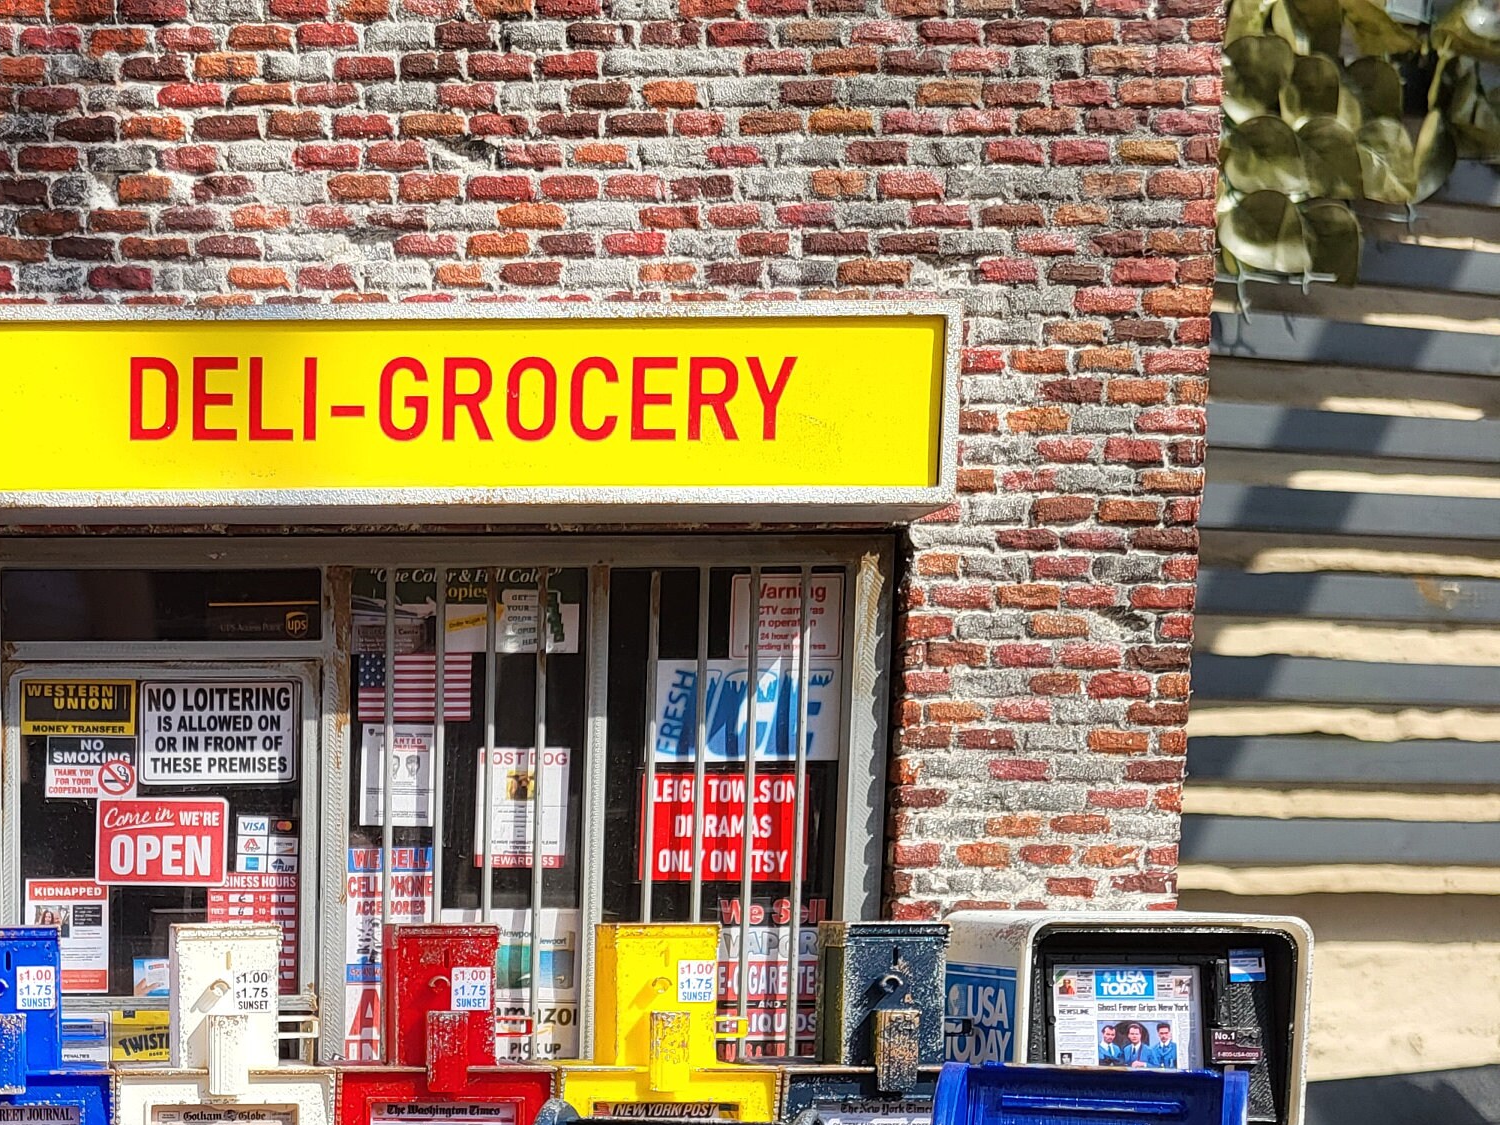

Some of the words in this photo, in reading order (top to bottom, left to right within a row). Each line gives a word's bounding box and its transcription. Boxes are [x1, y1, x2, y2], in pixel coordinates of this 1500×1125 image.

[128, 356, 798, 441] DELI-GROCERY
[26, 685, 114, 698] WESTERN
[53, 697, 114, 710] UNION
[146, 687, 176, 712] NO
[182, 687, 291, 712] LOITERING
[656, 668, 697, 755] FRESH
[32, 725, 68, 733] MONEY
[72, 725, 125, 734] TRANSFER
[157, 715, 173, 732] IS
[177, 715, 254, 732] ALLOWED
[257, 715, 281, 731] ON
[80, 740, 104, 751] NO
[154, 736, 178, 752] OR
[182, 736, 199, 752] IN
[203, 736, 257, 752] FRONT
[262, 735, 283, 752] OF
[53, 751, 131, 764] SMOKING
[150, 757, 203, 774] THESE
[207, 757, 288, 774] PREMISES
[53, 768, 77, 777] THANK
[79, 768, 94, 776] YOU
[48, 786, 99, 794] COOPERATION
[103, 804, 152, 829] Come
[154, 806, 175, 822] in
[179, 810, 220, 827] WE'RE
[242, 821, 266, 831] VISA
[109, 835, 212, 877] OPEN
[353, 851, 381, 869] WE
[261, 875, 296, 888] HOURS
[348, 875, 382, 898] CELL
[33, 885, 103, 898] KIDNAPPED
[720, 898, 764, 925] We
[771, 898, 827, 925] Sell
[18, 969, 52, 982] $1.00
[679, 963, 713, 975] $1.00
[235, 972, 269, 985] $1.00
[454, 970, 487, 982] $1.00
[1115, 970, 1146, 983] USA
[18, 985, 53, 997] $1.75
[454, 985, 487, 997] $1.75
[679, 978, 713, 991] $1.75
[1100, 982, 1149, 996] TODAY
[235, 987, 269, 999] $1.75
[681, 990, 712, 1001] SUNSET
[21, 997, 52, 1009] SUNSET
[237, 1000, 269, 1011] SUNSET
[456, 998, 487, 1008] SUNSET
[967, 985, 1009, 1029] USA
[1097, 1003, 1117, 1012] Ghost
[1119, 1004, 1137, 1012] Fever
[1138, 1003, 1157, 1013] Grips
[1158, 1004, 1174, 1012] New
[1174, 1004, 1189, 1012] York
[945, 1026, 1012, 1064] TODAY
[183, 1110, 222, 1122] Gotham
[238, 1110, 266, 1121] Globe
[386, 1104, 405, 1116] The
[406, 1104, 467, 1118] Washington
[468, 1104, 501, 1116] Times
[615, 1103, 645, 1117] NEW
[648, 1103, 679, 1117] YORK
[682, 1103, 716, 1117] POST
